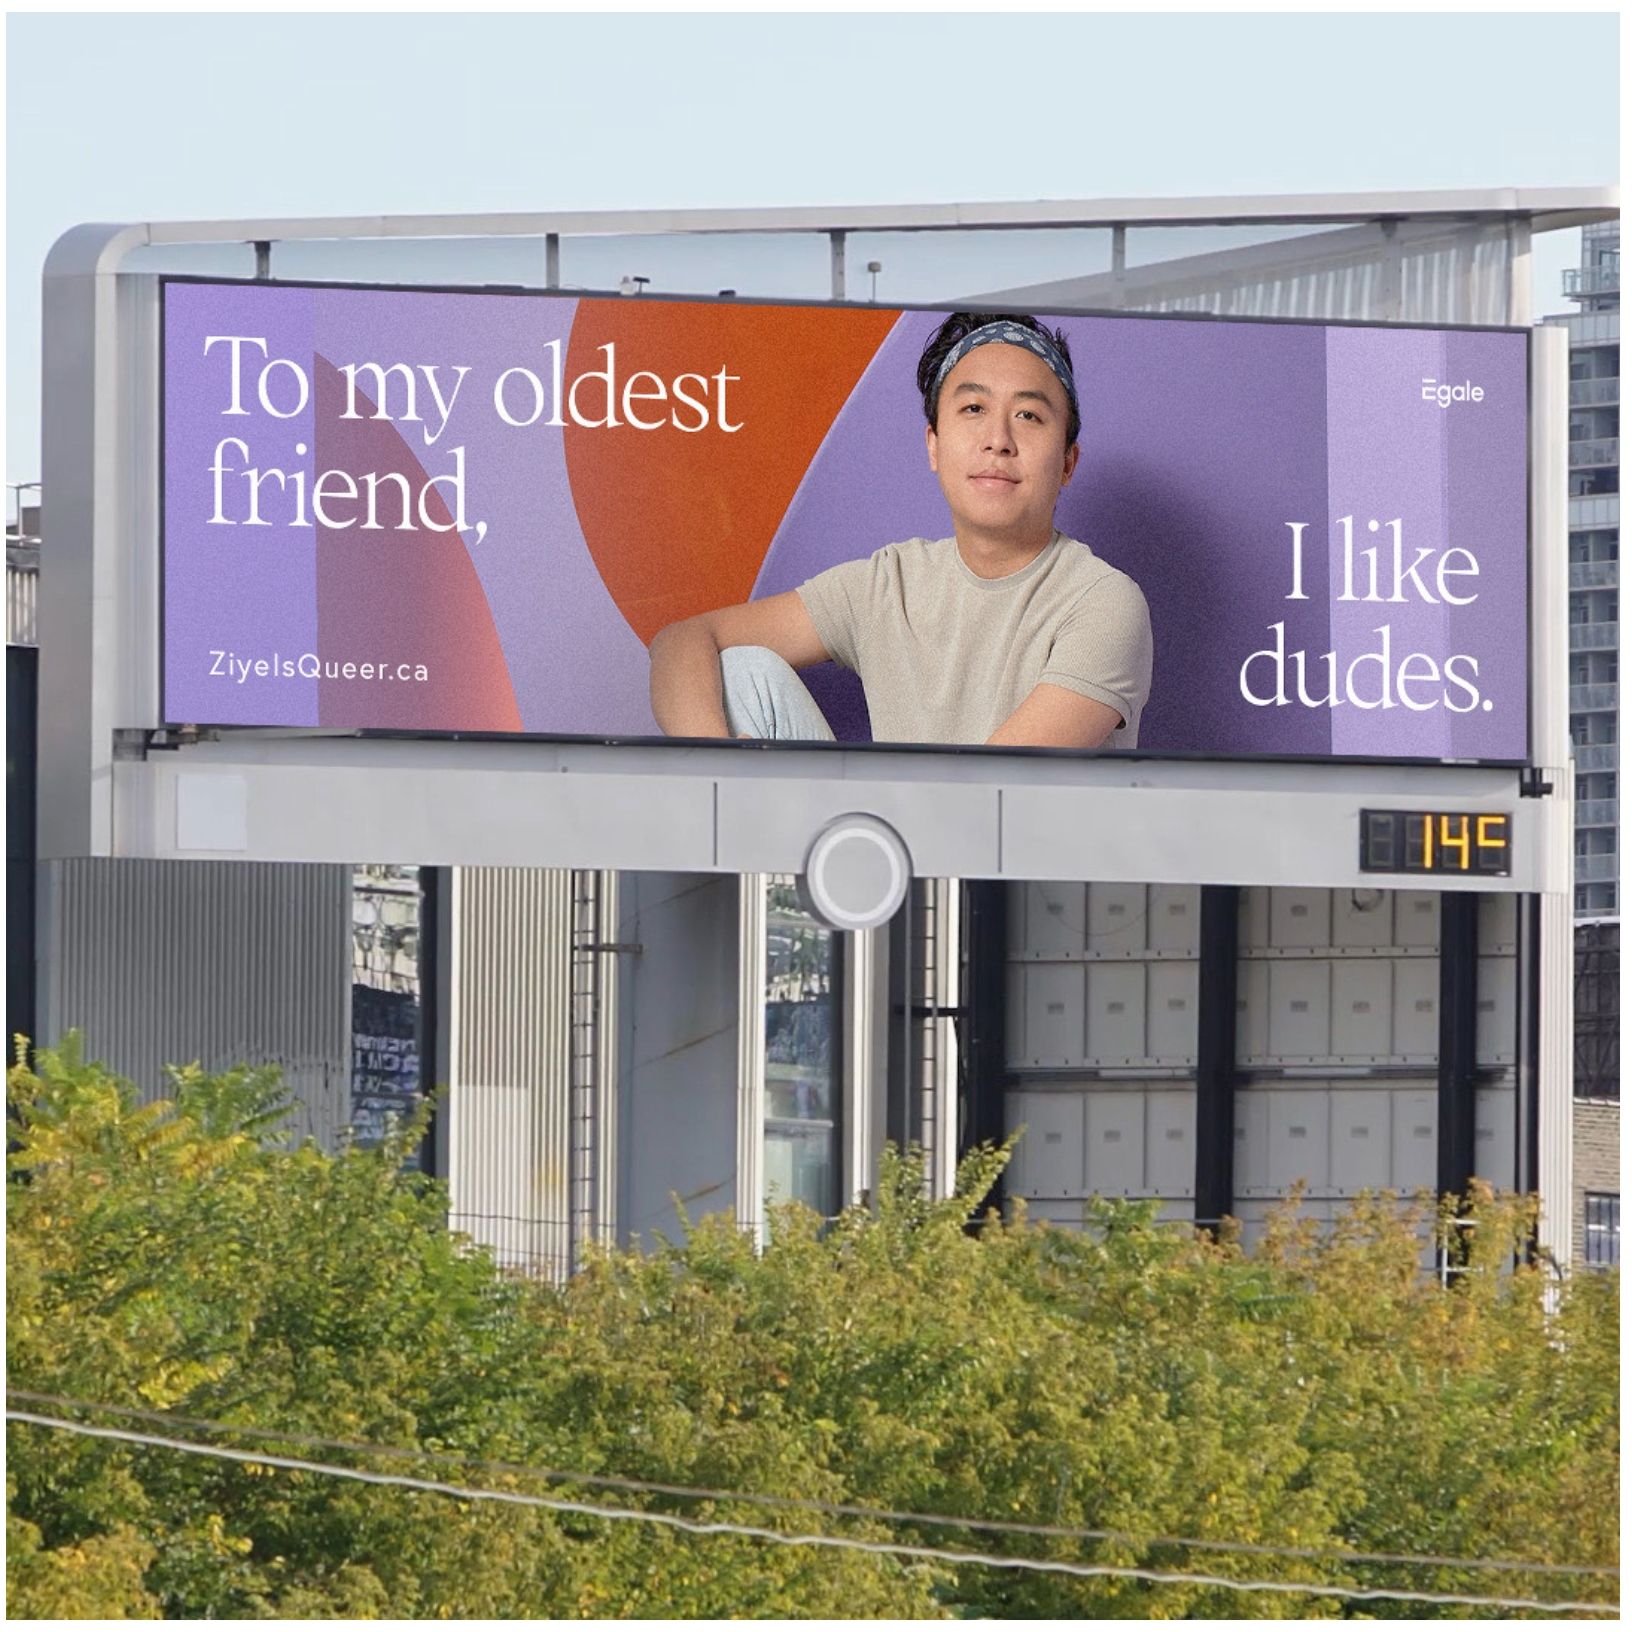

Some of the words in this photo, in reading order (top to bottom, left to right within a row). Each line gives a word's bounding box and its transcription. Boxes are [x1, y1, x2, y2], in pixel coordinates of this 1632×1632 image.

[203, 335, 310, 420] To
[337, 361, 472, 446] my
[493, 339, 746, 434] oldest
[206, 436, 490, 544] friend,
[1283, 522, 1311, 601] I
[1335, 514, 1481, 606] like
[208, 650, 431, 684] ZiyeIsQueer.ca
[1239, 621, 1495, 714] dudes.
